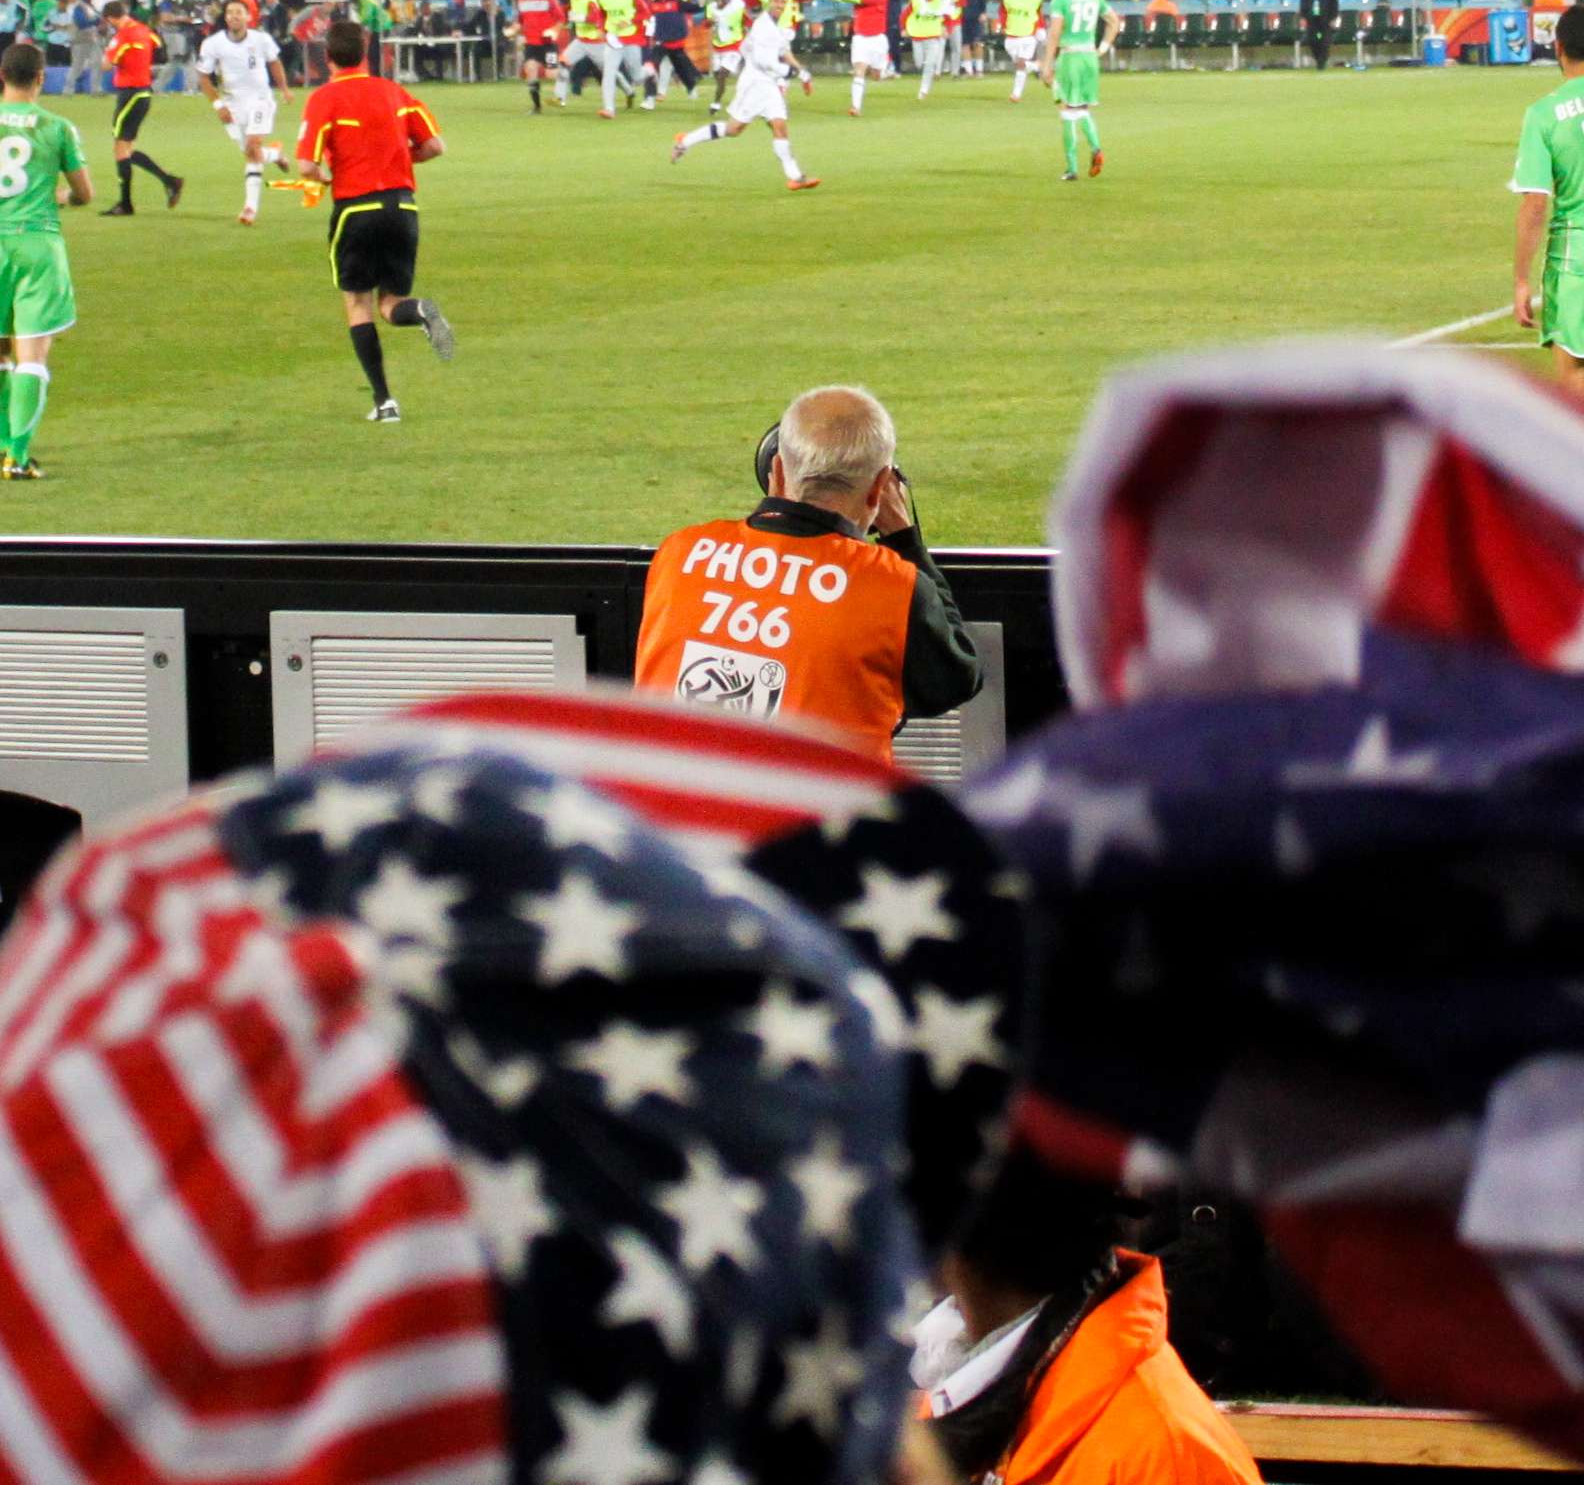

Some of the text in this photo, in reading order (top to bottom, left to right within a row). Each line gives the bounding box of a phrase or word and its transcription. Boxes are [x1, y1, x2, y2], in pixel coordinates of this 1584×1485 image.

[1069, 2, 1100, 33] 19
[681, 537, 849, 605] PHOTO
[699, 590, 792, 650] 766
